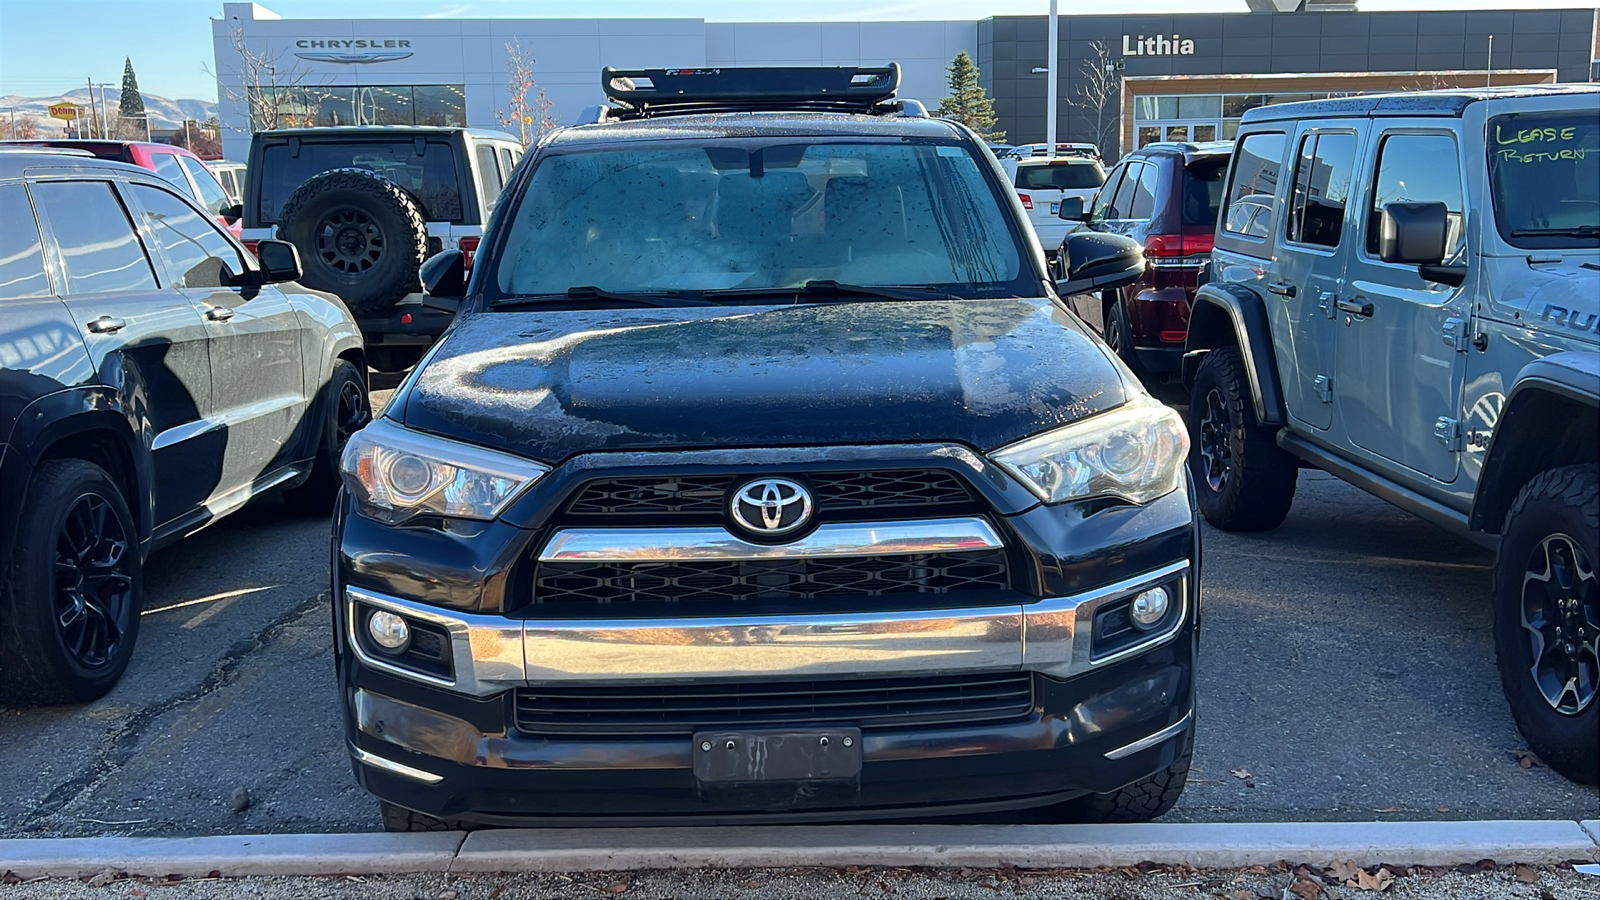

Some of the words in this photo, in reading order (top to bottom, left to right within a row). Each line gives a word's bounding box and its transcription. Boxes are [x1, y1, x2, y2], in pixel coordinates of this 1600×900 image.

[296, 40, 411, 48] CHRYSLER
[1122, 34, 1194, 55] Lithia
[51, 107, 84, 116] Dennys
[1496, 125, 1576, 145] LEASE
[1497, 147, 1585, 162] RETURN
[1541, 304, 1599, 334] RU
